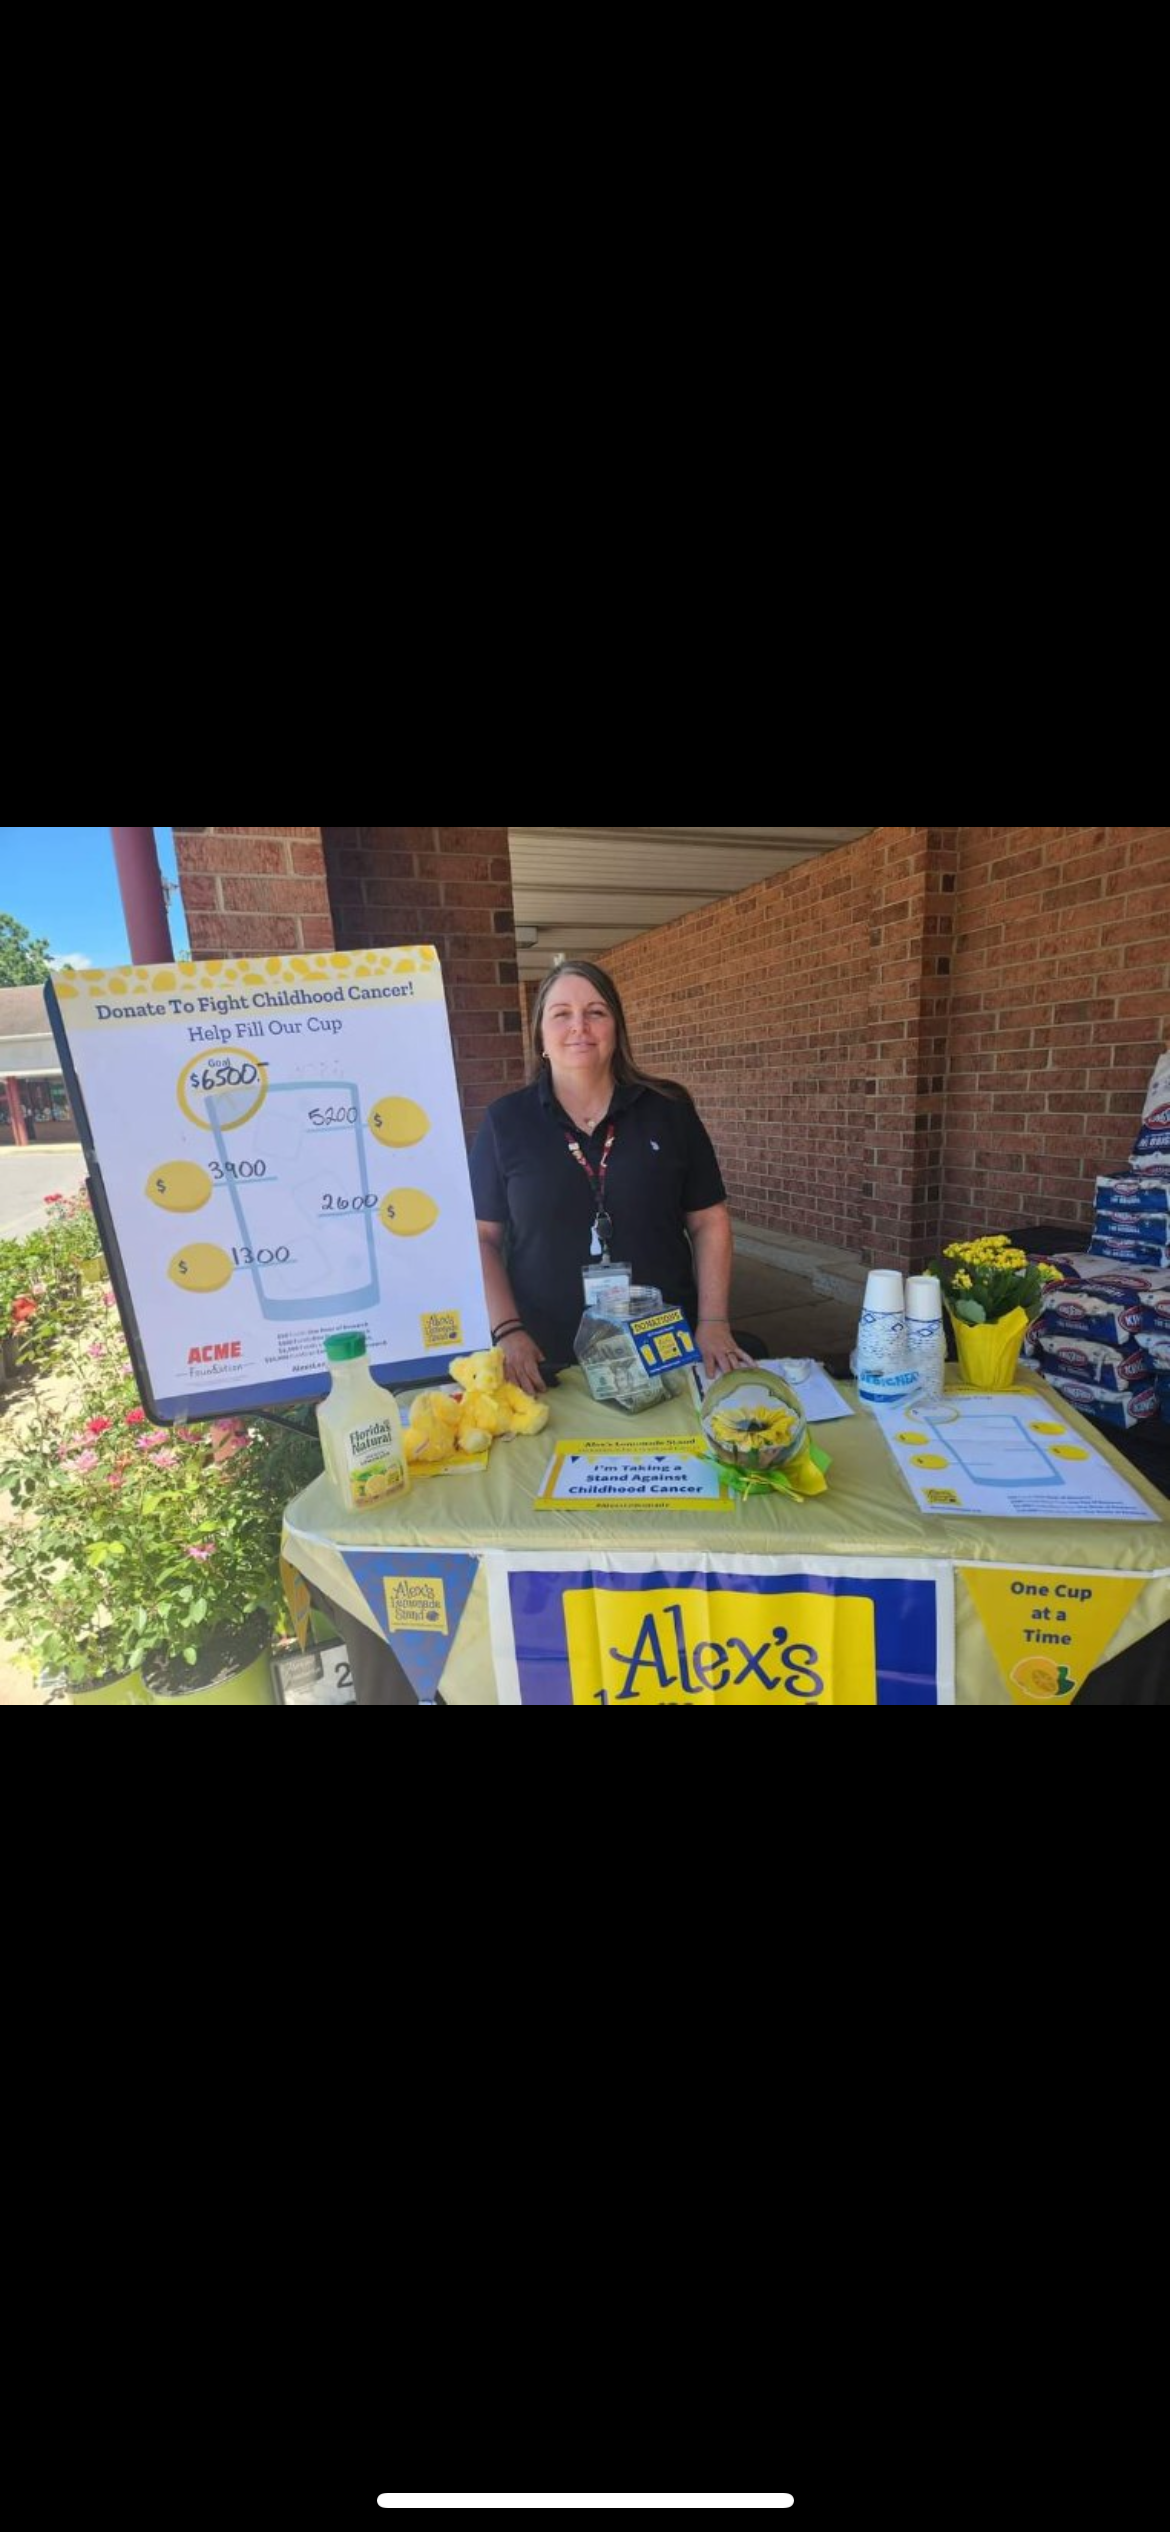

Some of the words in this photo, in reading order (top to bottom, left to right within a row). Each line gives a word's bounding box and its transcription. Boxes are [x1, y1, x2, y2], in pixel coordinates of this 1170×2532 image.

[95, 1003, 167, 1020] Donate
[168, 999, 195, 1014] To
[196, 994, 250, 1015] Fight
[252, 986, 345, 1008] Childhood
[347, 981, 415, 1000] Cancer!
[187, 1024, 232, 1043] Help
[235, 1020, 265, 1038] Fill
[268, 1019, 302, 1036] Our
[306, 1017, 343, 1034] Cup
[207, 1057, 232, 1068] Goal
[307, 1106, 358, 1126] 5200
[208, 1159, 266, 1180] 3900
[321, 1193, 378, 1211] 2600
[231, 1246, 290, 1266] 1300
[188, 1340, 242, 1365] ACME
[352, 1432, 392, 1456] Natural
[586, 1474, 629, 1482] Stand
[631, 1474, 688, 1482] Against
[594, 1464, 618, 1472] I'm
[622, 1464, 671, 1473] Taking
[568, 1485, 646, 1494] Childhood
[650, 1485, 704, 1494] Cancer
[392, 1580, 435, 1600] Alex's
[1010, 1581, 1050, 1597] One
[1054, 1584, 1093, 1602] Cup
[1031, 1607, 1051, 1621] at
[1055, 1610, 1067, 1621] a
[1023, 1629, 1073, 1645] Time
[609, 1603, 825, 1700] Alex's
